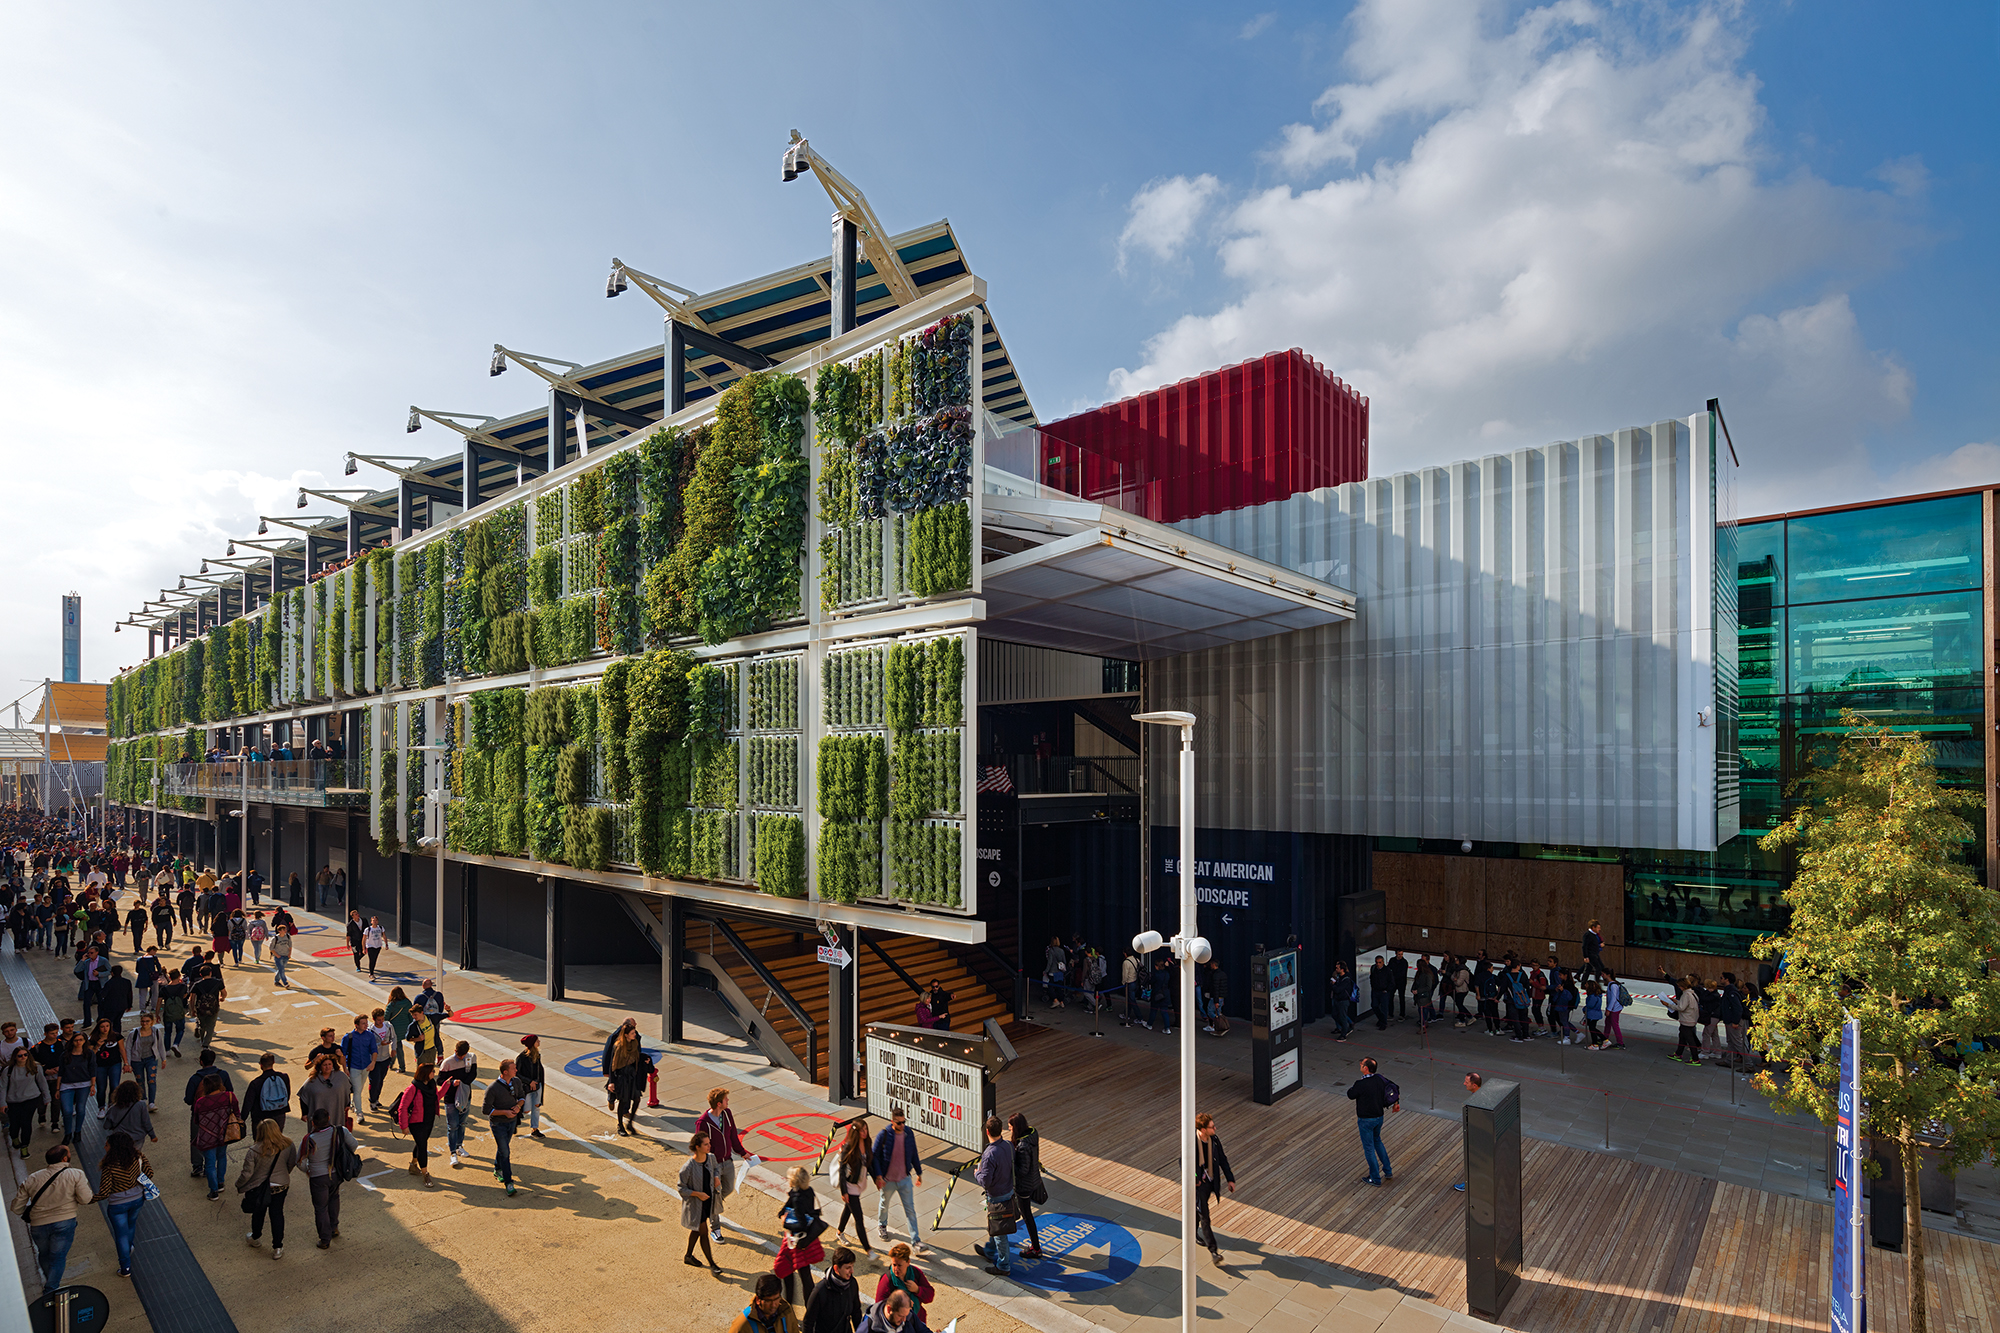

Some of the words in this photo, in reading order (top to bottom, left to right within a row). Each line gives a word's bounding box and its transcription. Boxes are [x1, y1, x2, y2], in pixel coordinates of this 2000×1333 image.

[1165, 858, 1173, 873] THE
[1176, 859, 1211, 877] GEAT
[1213, 862, 1273, 881] AMERICAN
[1194, 887, 1249, 907] ODSCAPE
[880, 1049, 896, 1067] FOOD
[906, 1057, 930, 1078] TRUCK
[940, 1067, 970, 1090] NATION
[886, 1066, 939, 1097] CHEESEBURGER
[886, 1082, 921, 1106] AMERICAN
[928, 1095, 947, 1115] FOOD
[949, 1102, 962, 1120] 2.0
[920, 1108, 945, 1131] SALAD
